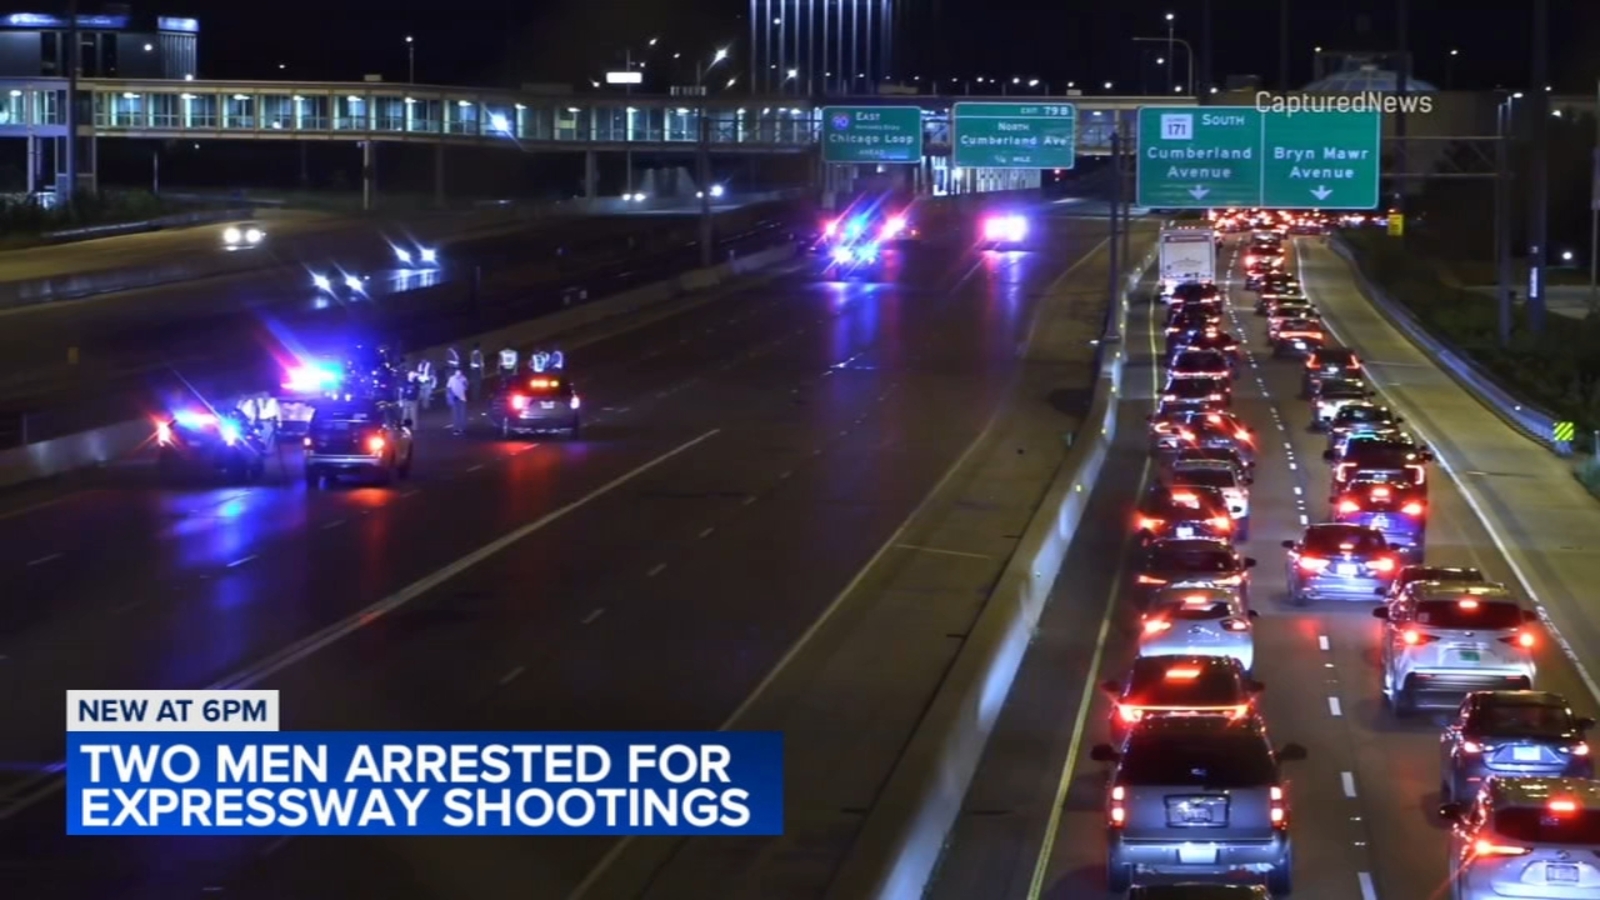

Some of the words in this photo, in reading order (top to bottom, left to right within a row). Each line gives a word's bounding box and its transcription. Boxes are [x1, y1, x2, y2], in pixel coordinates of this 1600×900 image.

[855, 112, 881, 121] EAST
[1202, 114, 1245, 126] SOUTH
[998, 121, 1030, 131] NORTH
[1167, 123, 1186, 136] 171
[829, 133, 880, 146] Chicago
[884, 134, 914, 146] Loop
[960, 135, 1037, 146] Cumberland
[1043, 135, 1068, 146] Ave
[1147, 146, 1252, 159] Cumberland
[1273, 146, 1315, 163] Bryn
[1323, 146, 1370, 160] Mawr
[1167, 165, 1232, 179] Avenue
[1289, 166, 1355, 179] Avenue
